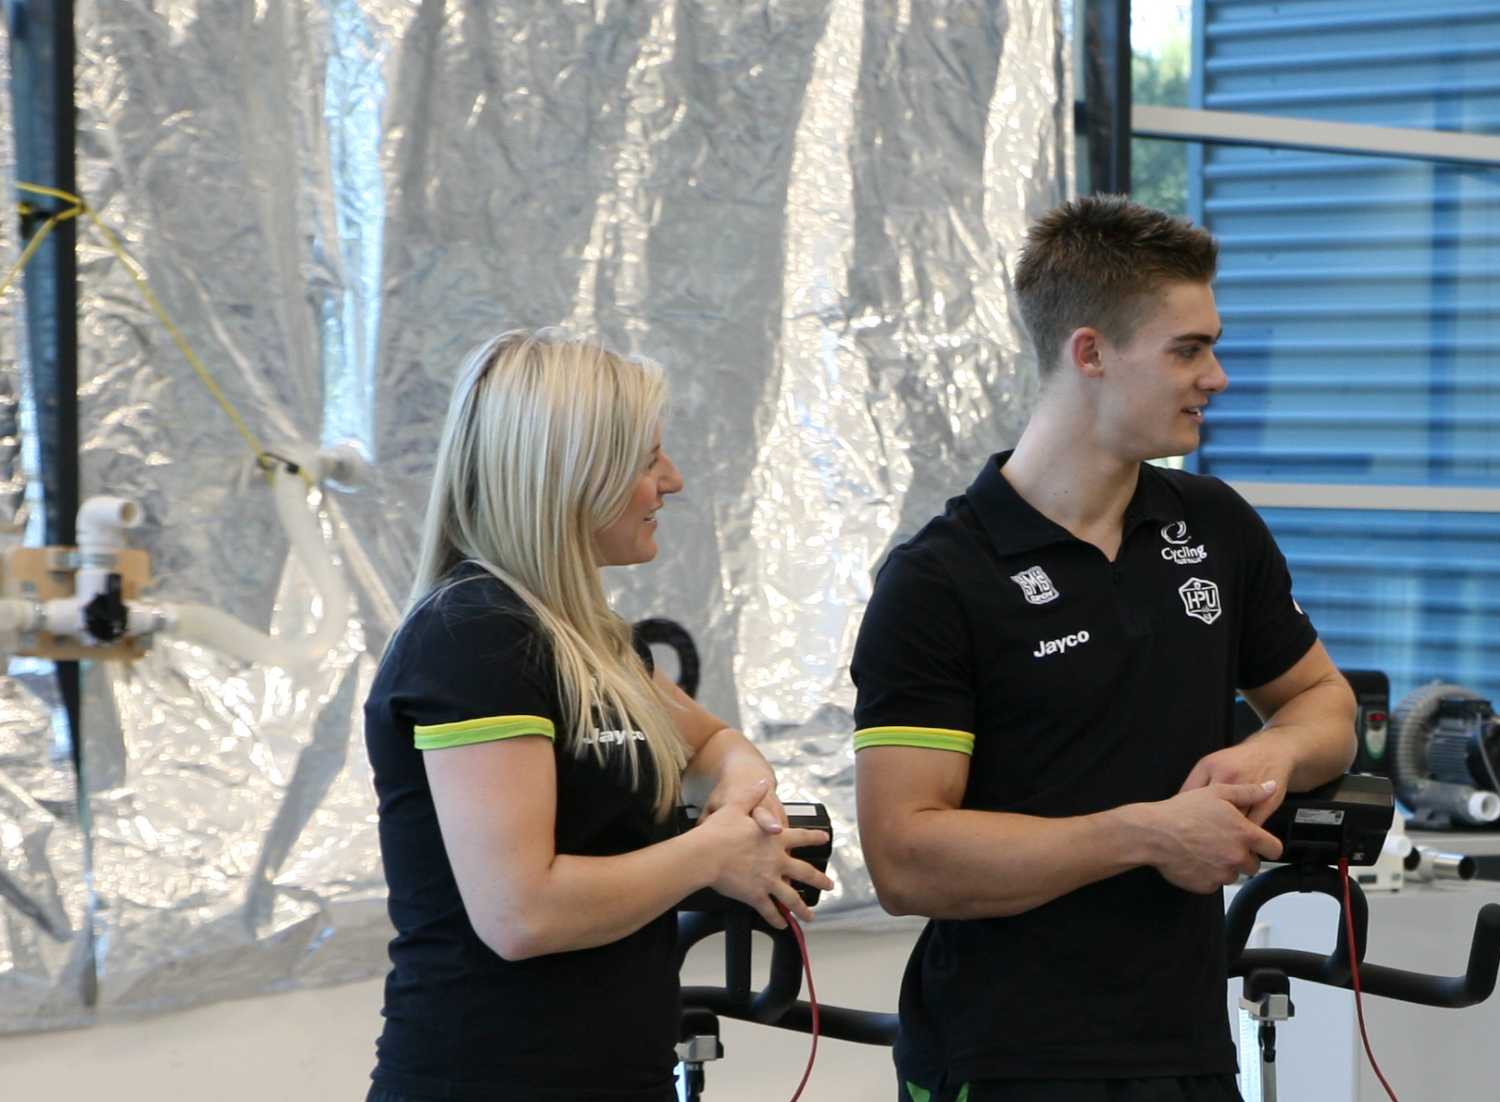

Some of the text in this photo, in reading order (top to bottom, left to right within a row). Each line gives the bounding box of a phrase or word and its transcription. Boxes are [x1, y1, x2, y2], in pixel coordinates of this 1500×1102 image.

[1161, 545, 1207, 562] Cycling
[1187, 589, 1217, 610] HPU
[1033, 630, 1090, 658] Jayco
